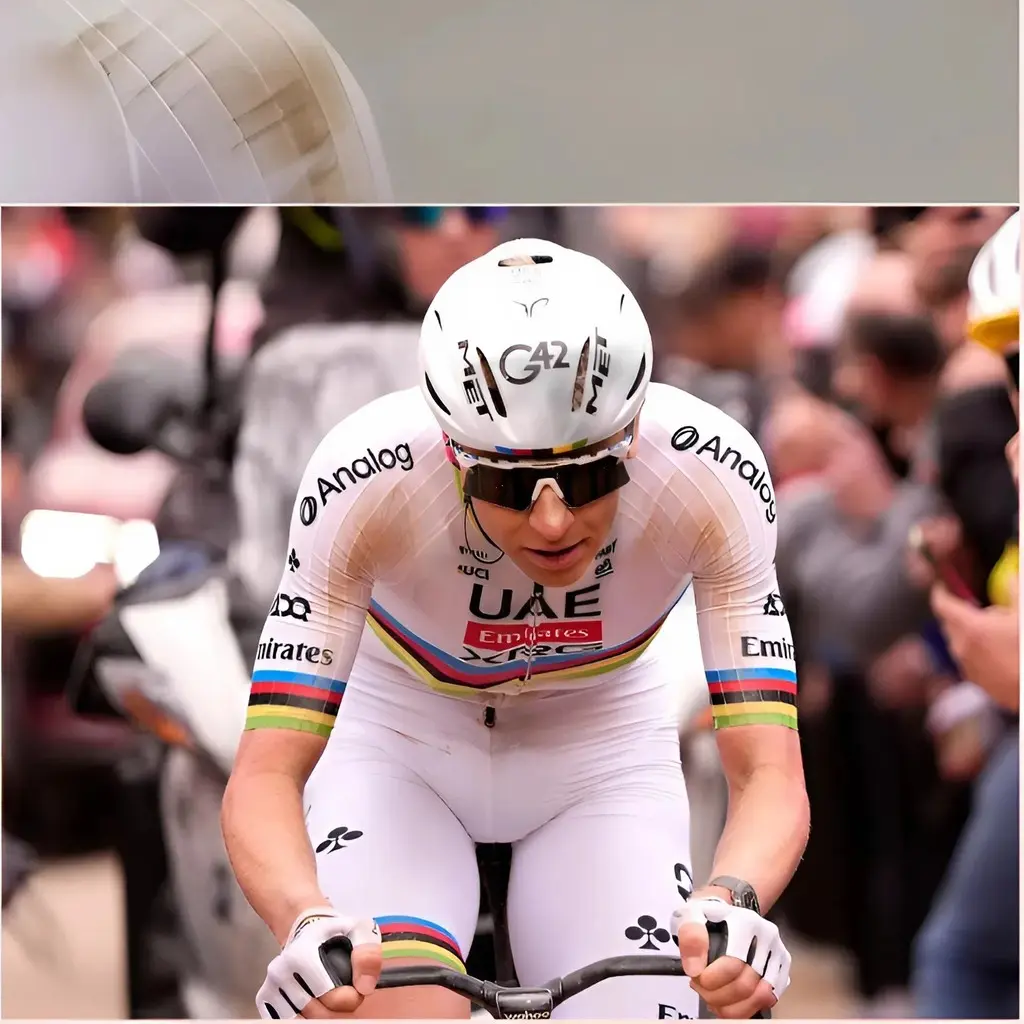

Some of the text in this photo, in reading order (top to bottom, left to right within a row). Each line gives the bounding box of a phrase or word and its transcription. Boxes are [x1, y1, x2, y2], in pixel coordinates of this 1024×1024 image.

[457, 339, 494, 422] MET
[499, 340, 570, 385] G42
[585, 326, 611, 415] MET
[317, 442, 414, 507] Analog
[468, 581, 602, 621] UAE
